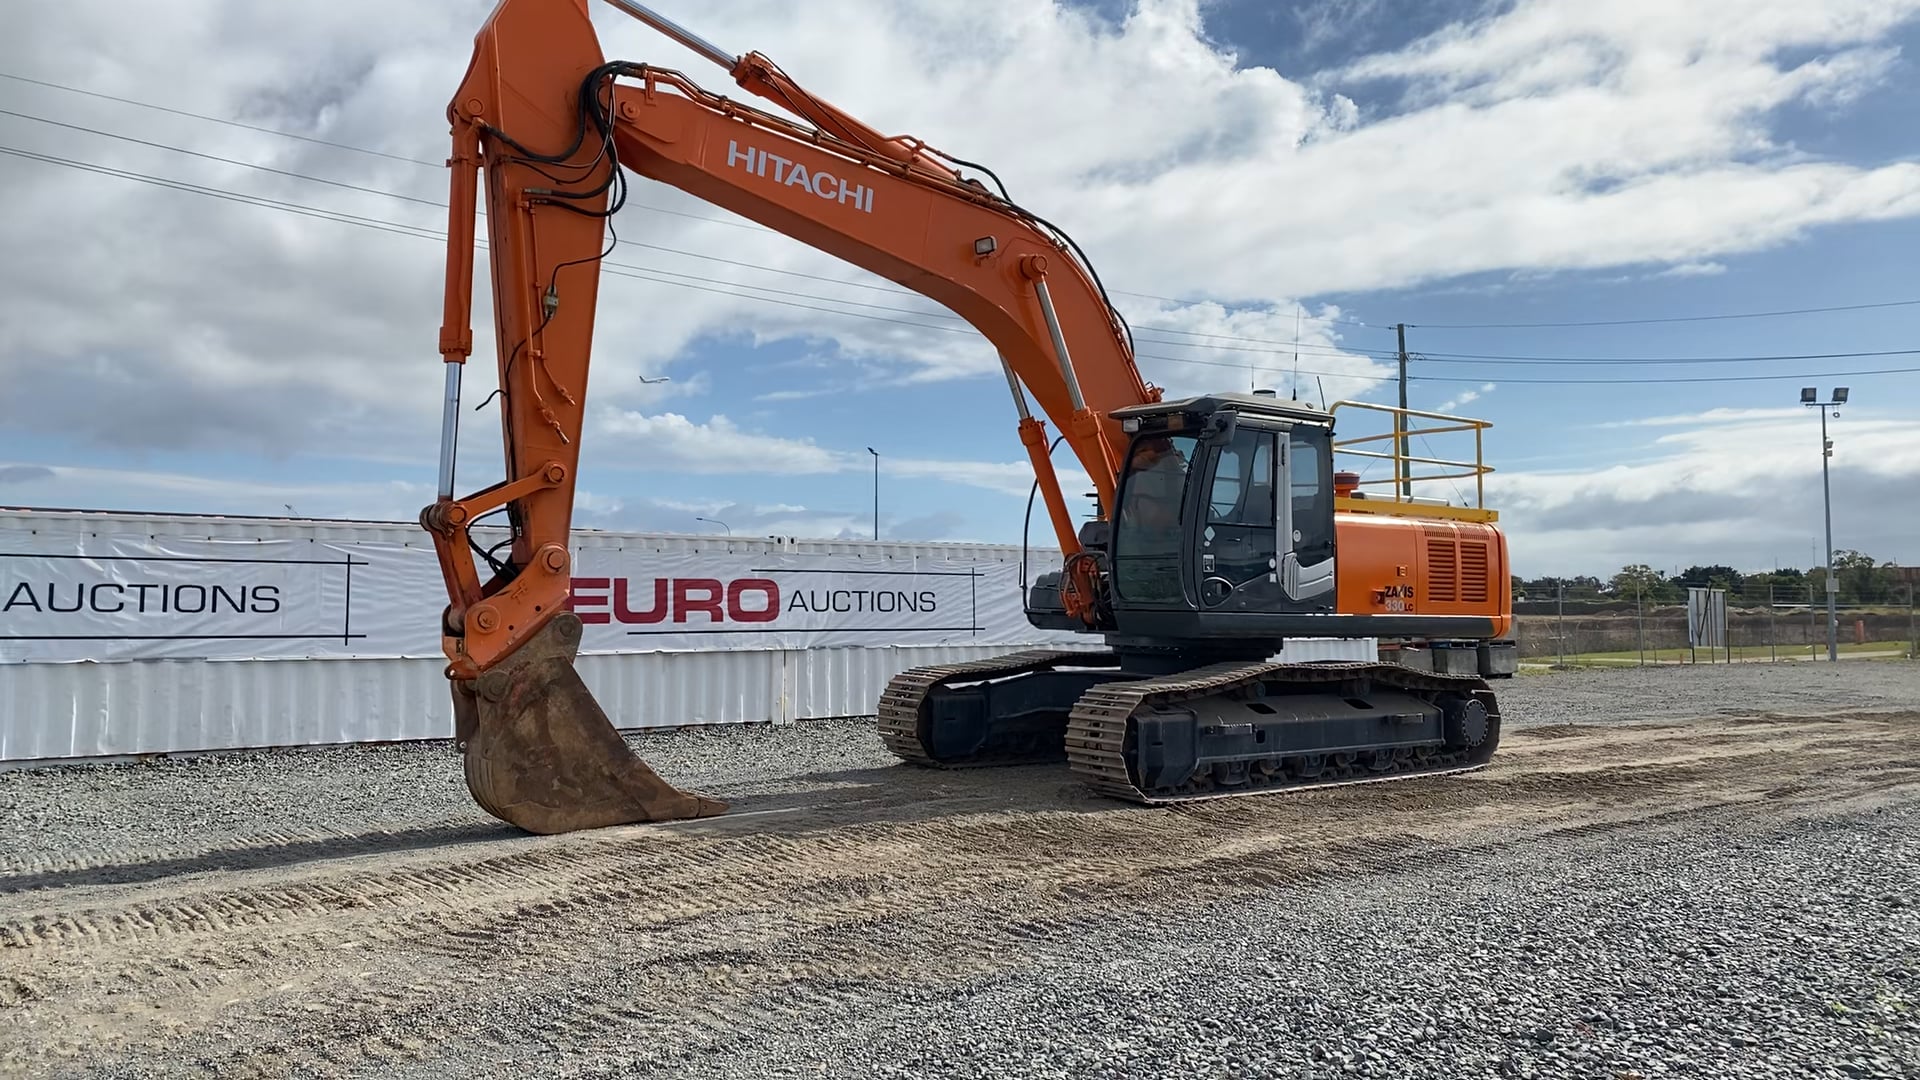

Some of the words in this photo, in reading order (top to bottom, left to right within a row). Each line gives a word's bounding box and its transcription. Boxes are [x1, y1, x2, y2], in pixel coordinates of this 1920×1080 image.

[728, 140, 874, 213] HITACHI
[3, 582, 280, 613] AUCTIONS
[571, 578, 779, 624] EURO
[788, 590, 936, 612] AUCTIONS
[1385, 585, 1414, 598] ZAXIS
